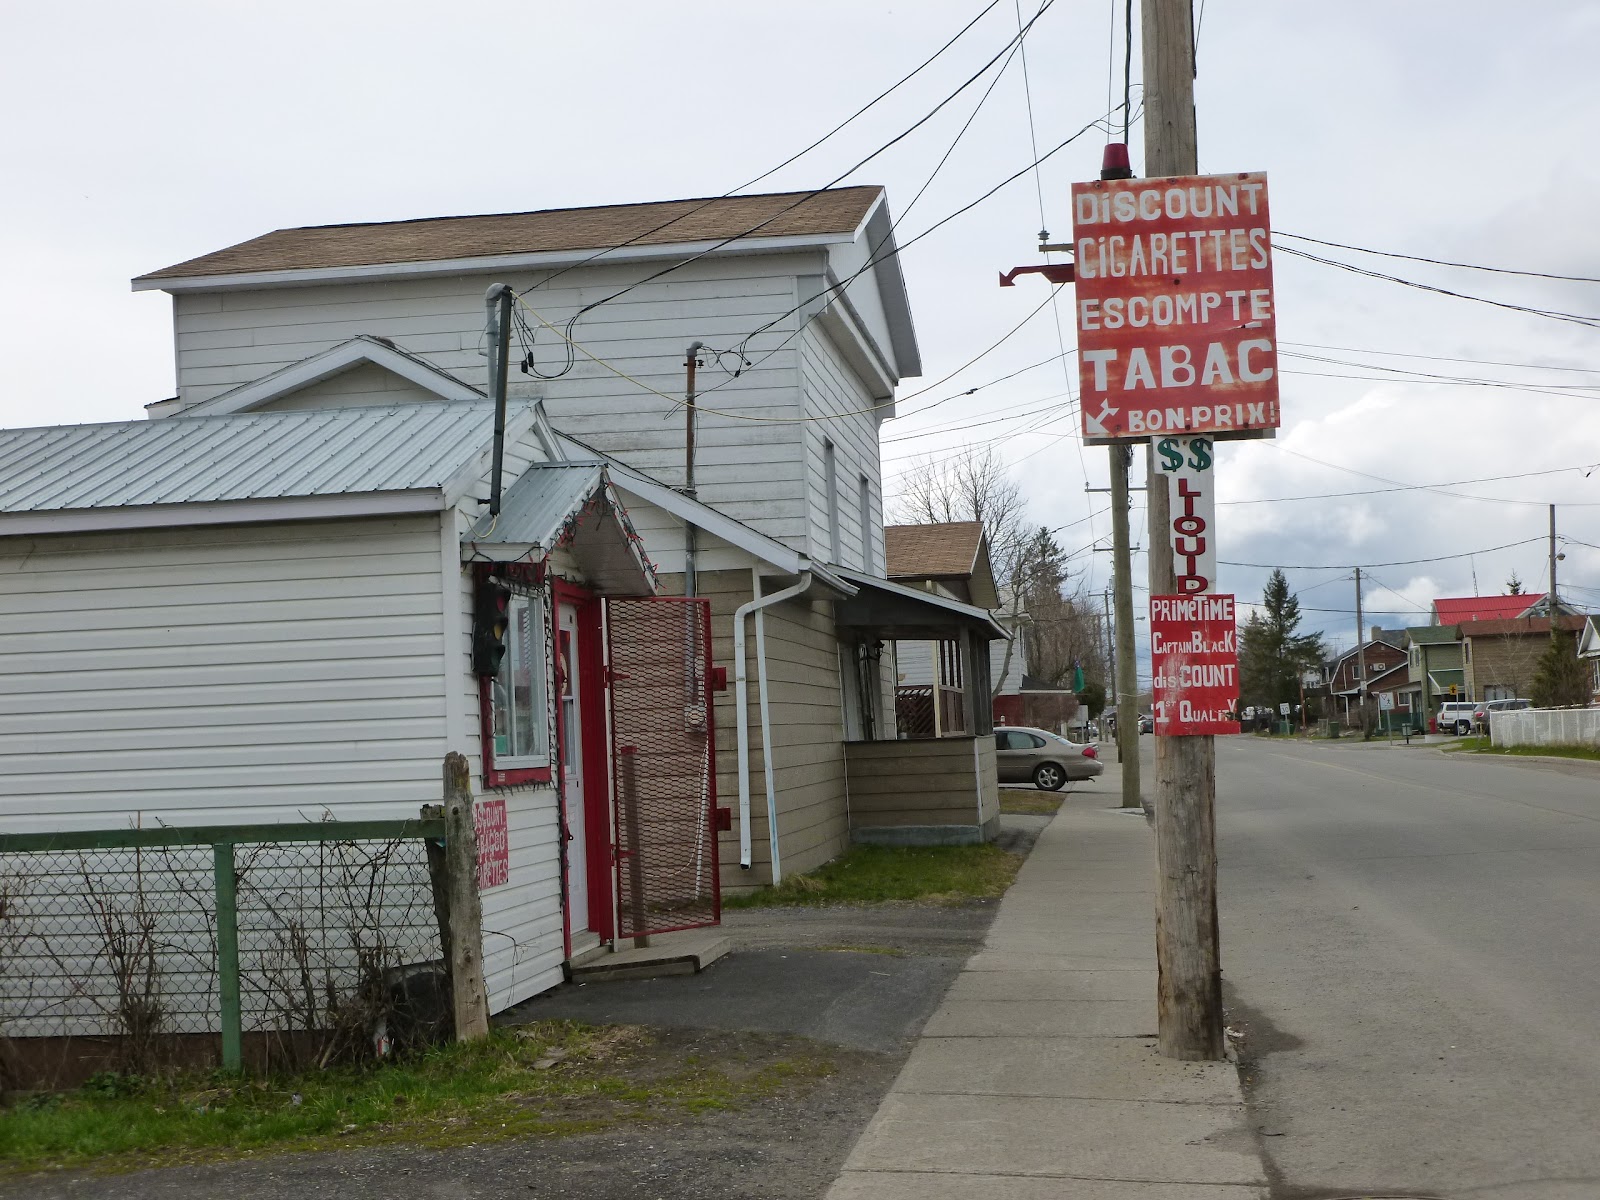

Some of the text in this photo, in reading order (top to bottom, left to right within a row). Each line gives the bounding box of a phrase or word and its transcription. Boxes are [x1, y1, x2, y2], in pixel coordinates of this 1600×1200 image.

[1076, 183, 1263, 225] DiSCOUNT
[1078, 227, 1268, 279] CiGARETTES
[1081, 289, 1271, 330] ESCOMPTE
[1083, 339, 1274, 392] TABAC
[1173, 478, 1209, 594] LIQUID
